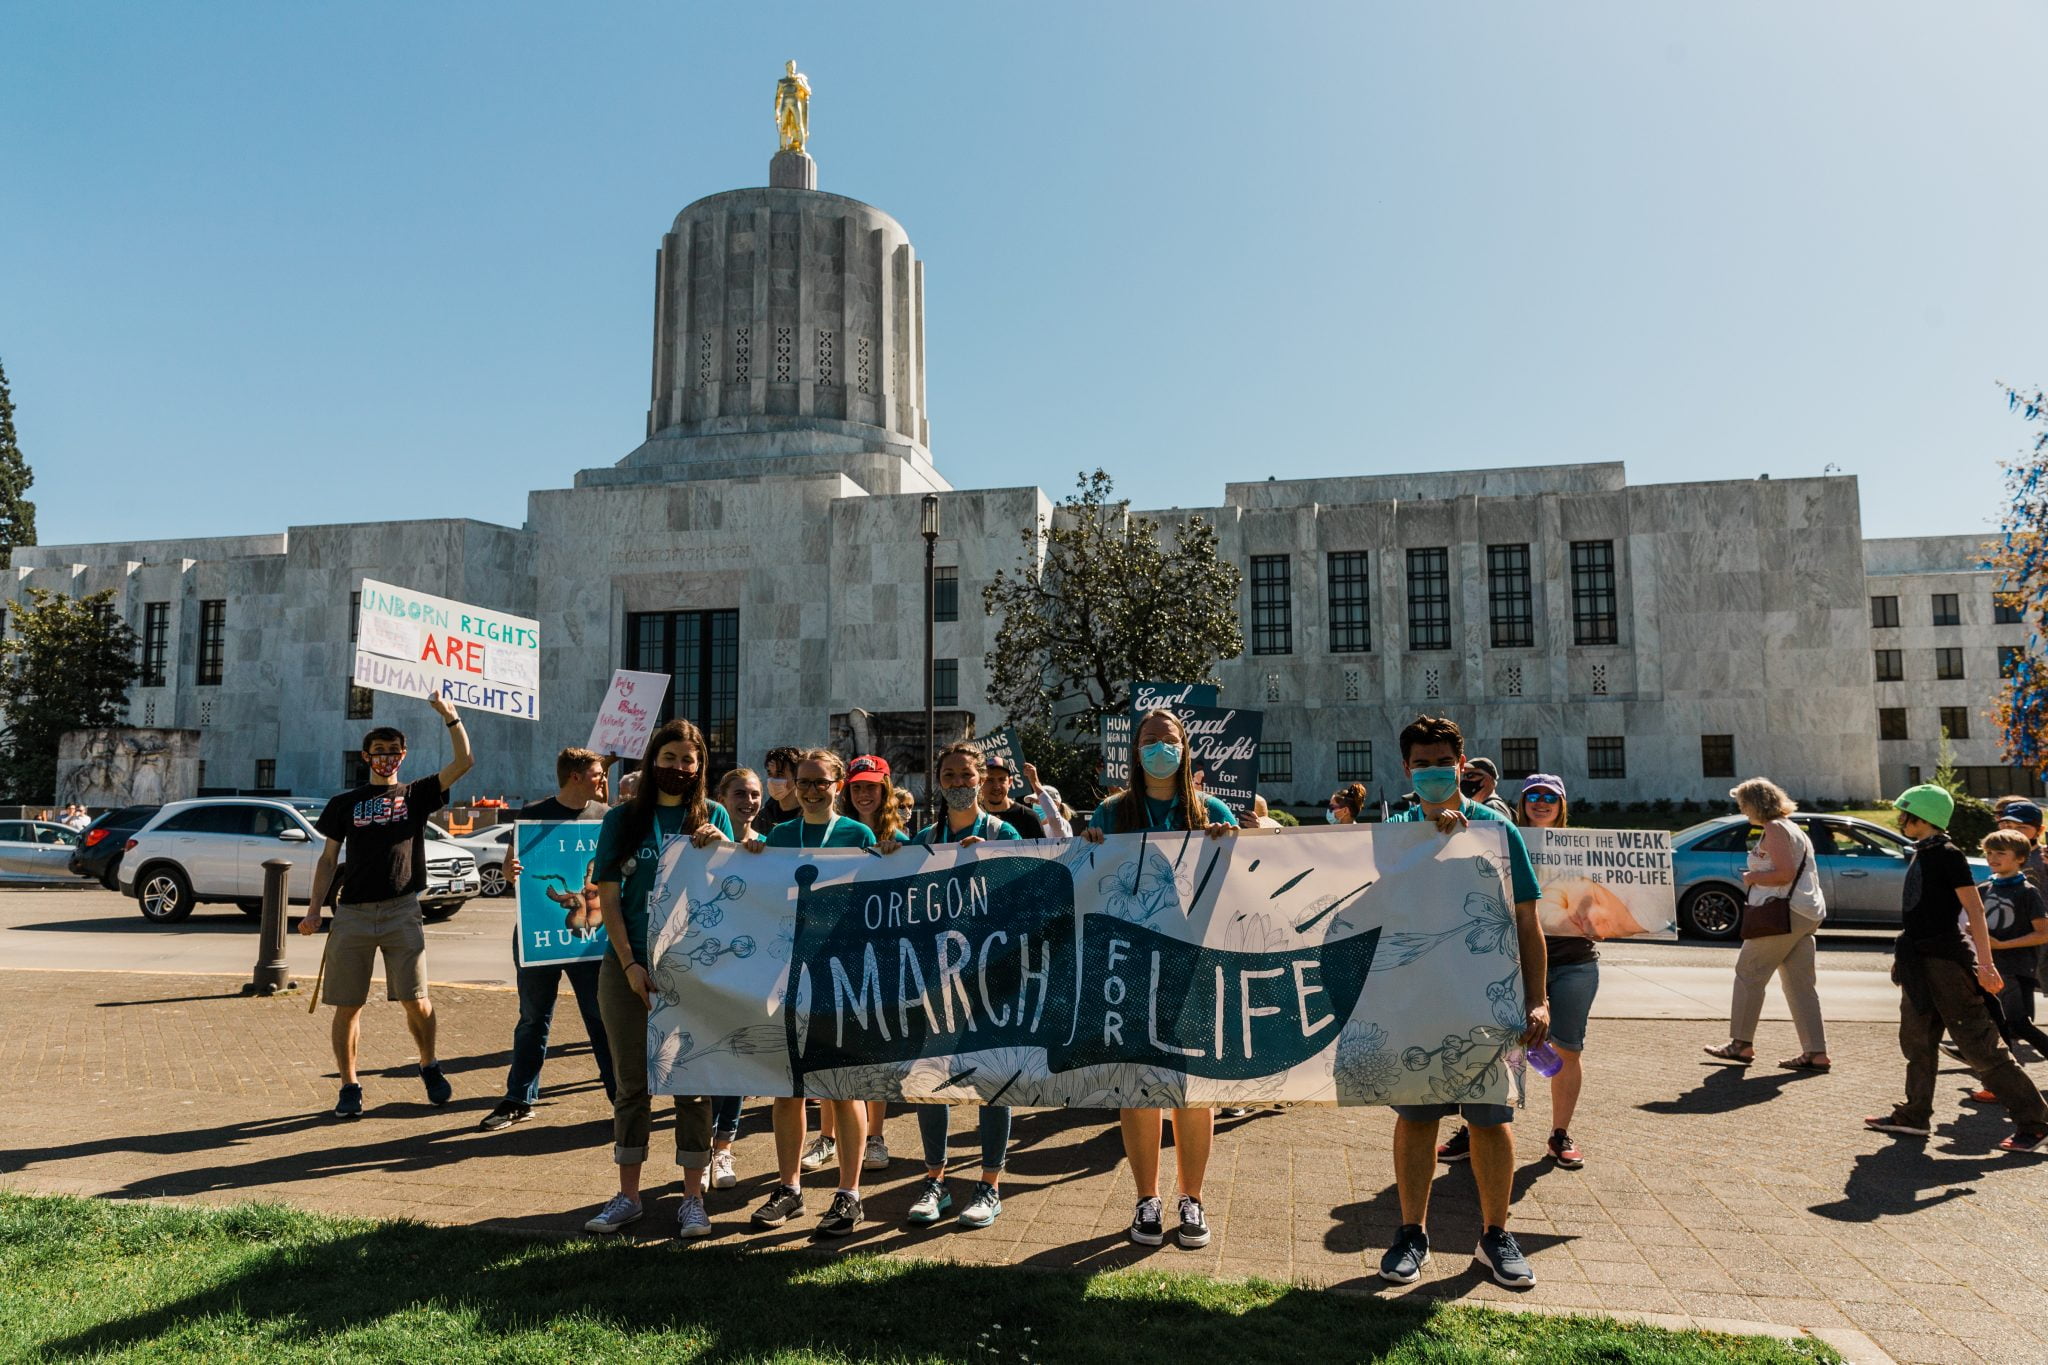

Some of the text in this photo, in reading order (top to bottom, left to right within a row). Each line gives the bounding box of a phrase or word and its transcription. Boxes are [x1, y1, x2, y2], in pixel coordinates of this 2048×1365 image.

[362, 588, 449, 629] UNBORN
[461, 614, 538, 649] RIGHTS
[421, 633, 485, 674] ARE
[356, 656, 535, 719] HUMAN RIGHTS!
[1135, 684, 1193, 712] Equal
[1107, 718, 1131, 732] HUM
[1178, 709, 1236, 737] Equal
[1107, 746, 1128, 762] SO DO
[1191, 736, 1257, 771] Rights
[1107, 763, 1129, 779] RIG
[1218, 770, 1238, 783] for
[1203, 782, 1252, 799] humans
[353, 796, 408, 828] USA
[559, 839, 599, 852] I AM
[1617, 832, 1668, 849] WEAK.
[1528, 850, 1670, 869] EFEND THE INNOCENT.
[1592, 873, 1603, 883] BE
[1606, 870, 1671, 886] PRO-LIFE.
[865, 877, 988, 930] OREGON
[533, 926, 609, 948] HUM
[829, 930, 1336, 1060] MARCH FOR LIFE
